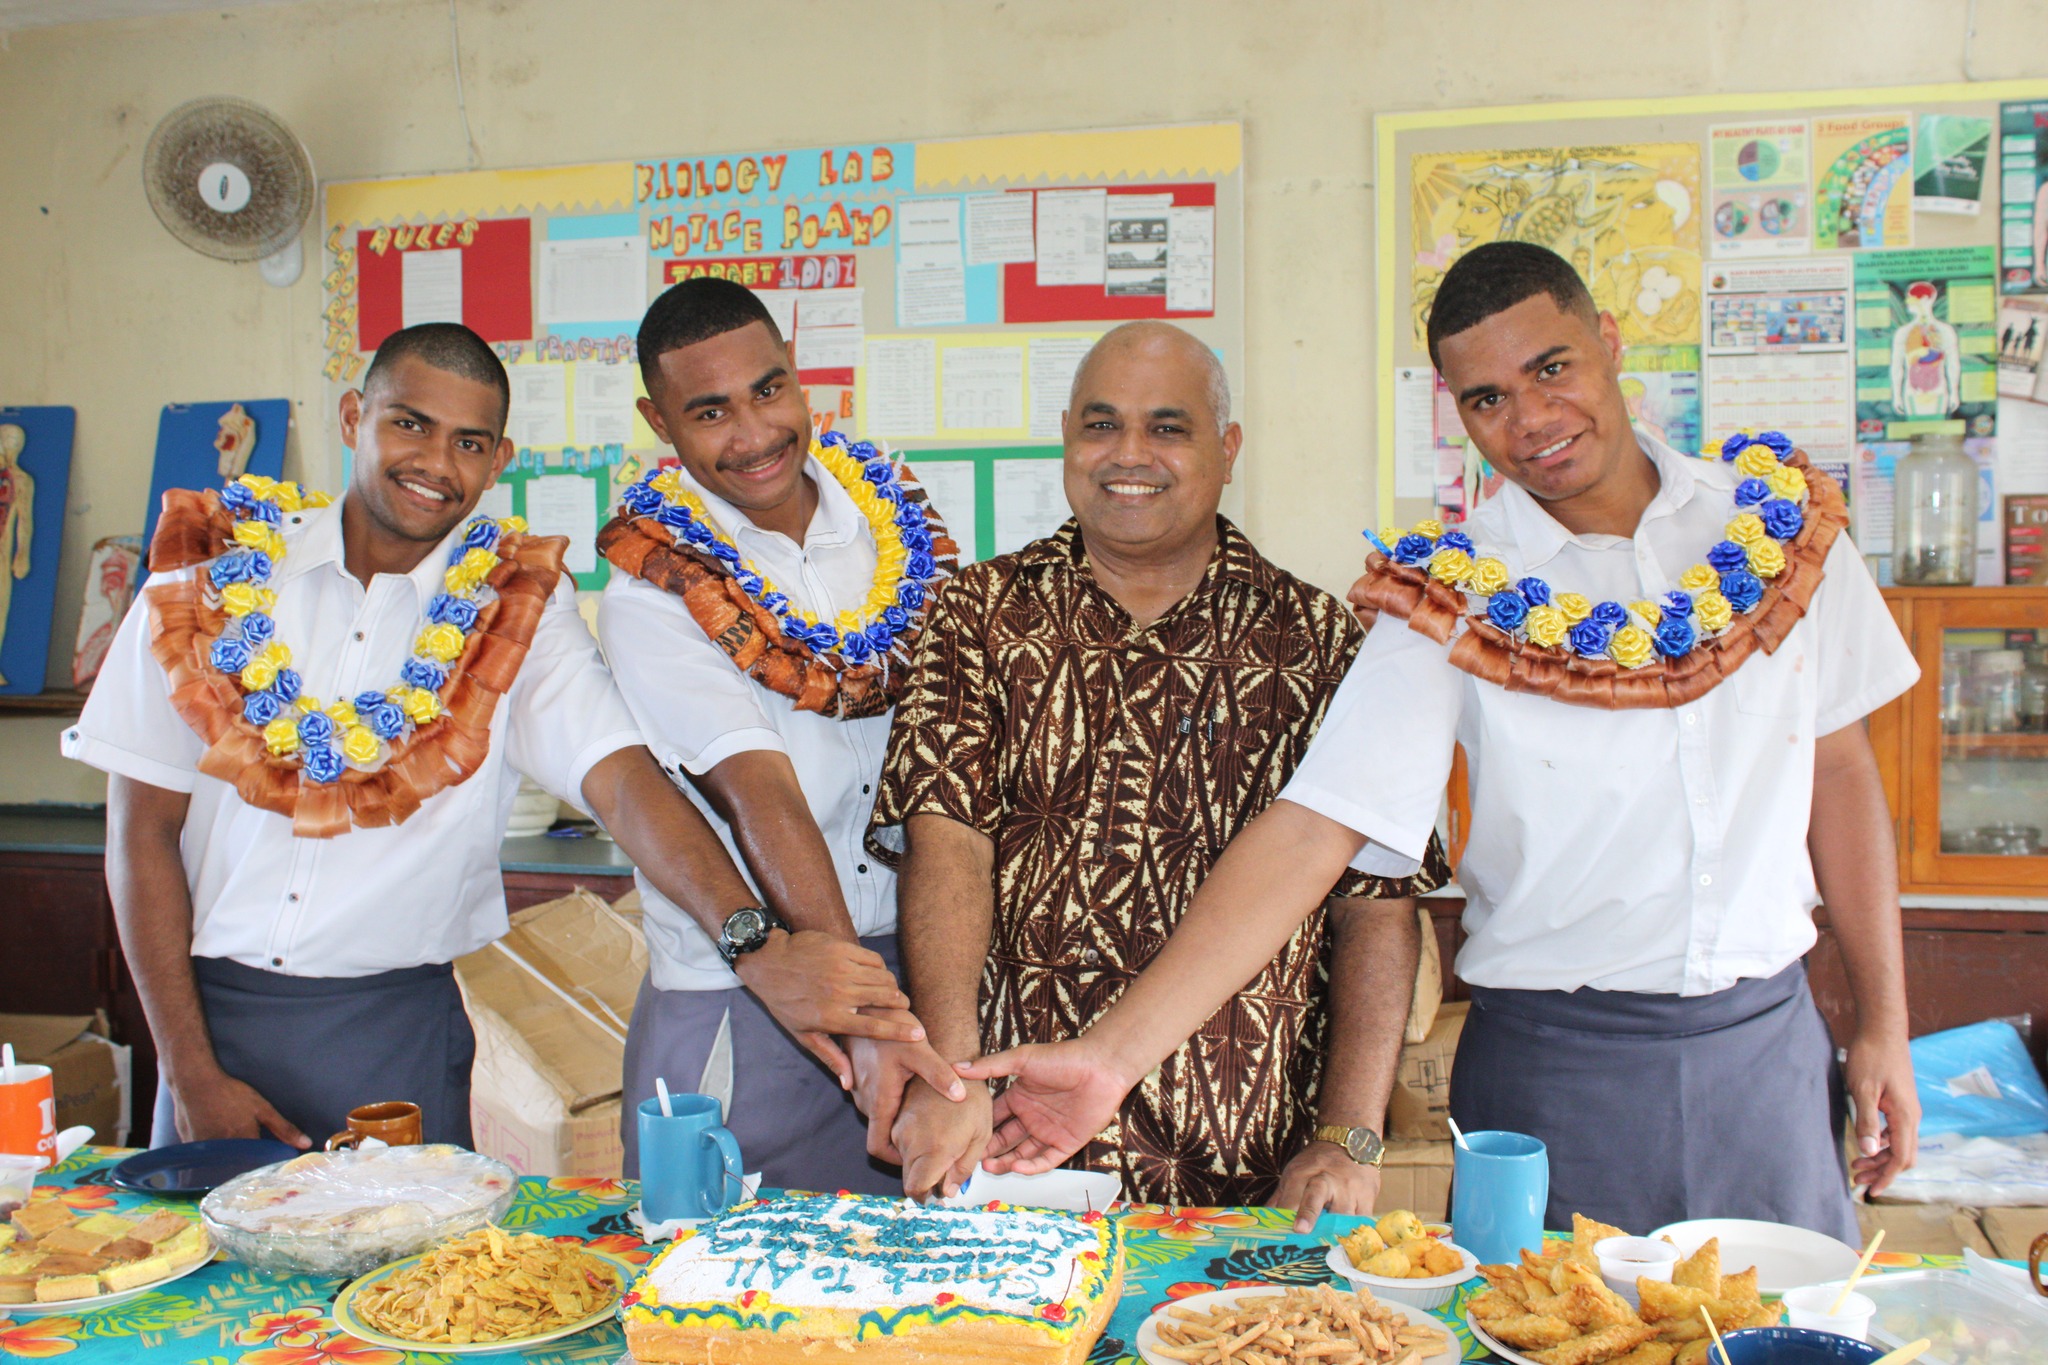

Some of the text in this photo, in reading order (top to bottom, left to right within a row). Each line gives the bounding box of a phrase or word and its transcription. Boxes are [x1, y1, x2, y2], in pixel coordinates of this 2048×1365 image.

[1827, 121, 1857, 131] Food
[1861, 119, 1905, 131] Groups
[635, 147, 895, 202] BIOLOGY LAB
[368, 216, 479, 257] RULES
[649, 201, 892, 257] NOTICE BOARD
[496, 333, 639, 365] OF PRACTICA
[562, 443, 624, 474] PLAN
